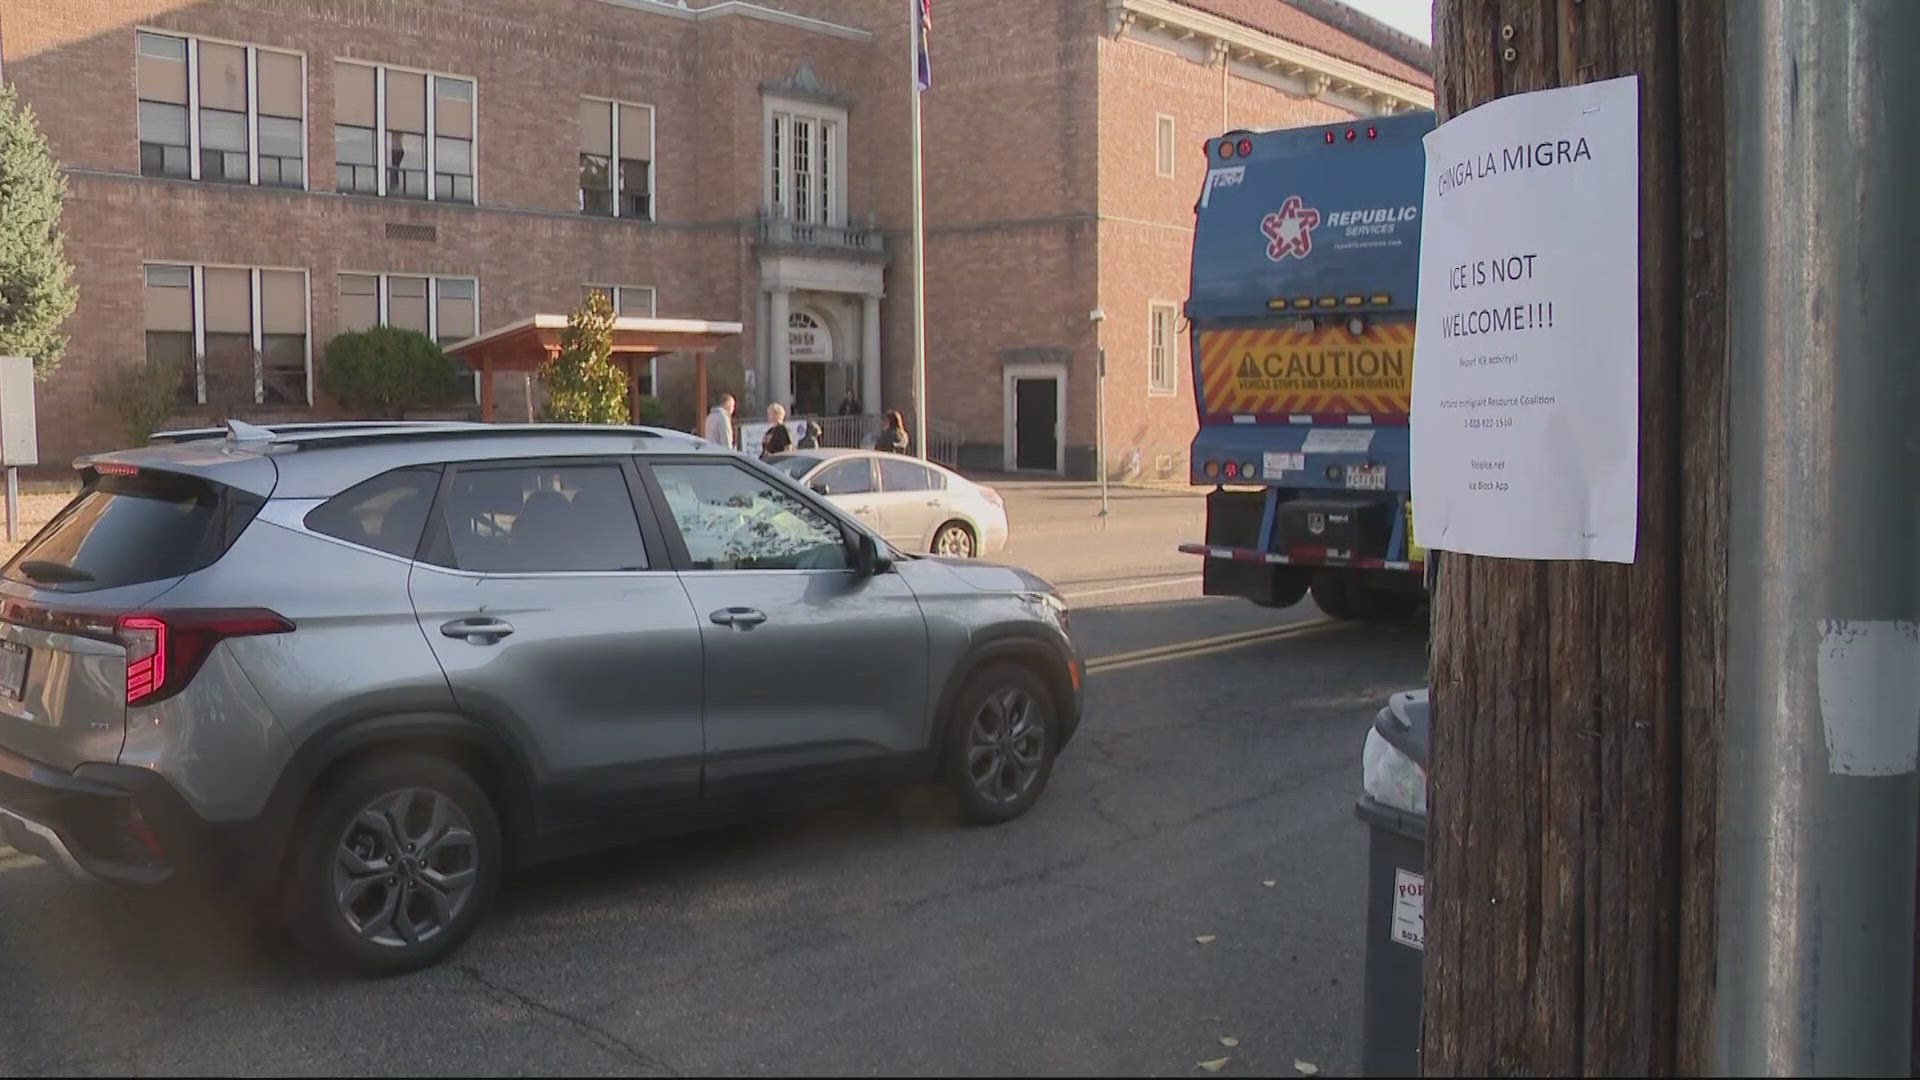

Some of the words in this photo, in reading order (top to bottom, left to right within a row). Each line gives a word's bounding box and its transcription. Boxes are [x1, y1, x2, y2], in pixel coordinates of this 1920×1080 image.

[1477, 152, 1497, 178] LA
[1502, 137, 1592, 173] MIGRA
[1327, 206, 1417, 227] REPUBLIC
[1344, 223, 1395, 236] SERVICES
[1450, 264, 1468, 291] ICE
[1472, 260, 1486, 287] IS
[1492, 253, 1538, 284] NOT
[1442, 301, 1553, 340] WELCOME!!!
[1263, 350, 1404, 378] CAUTION
[1239, 379, 1271, 390] VEHICLE
[1273, 379, 1299, 390] STOPS
[1301, 379, 1318, 390] AND
[1320, 378, 1348, 389] BACKS
[1350, 378, 1405, 389] FREQUENTLY
[1488, 396, 1519, 407] Resource
[1520, 394, 1555, 406] Coalition
[1495, 480, 1509, 492] App
